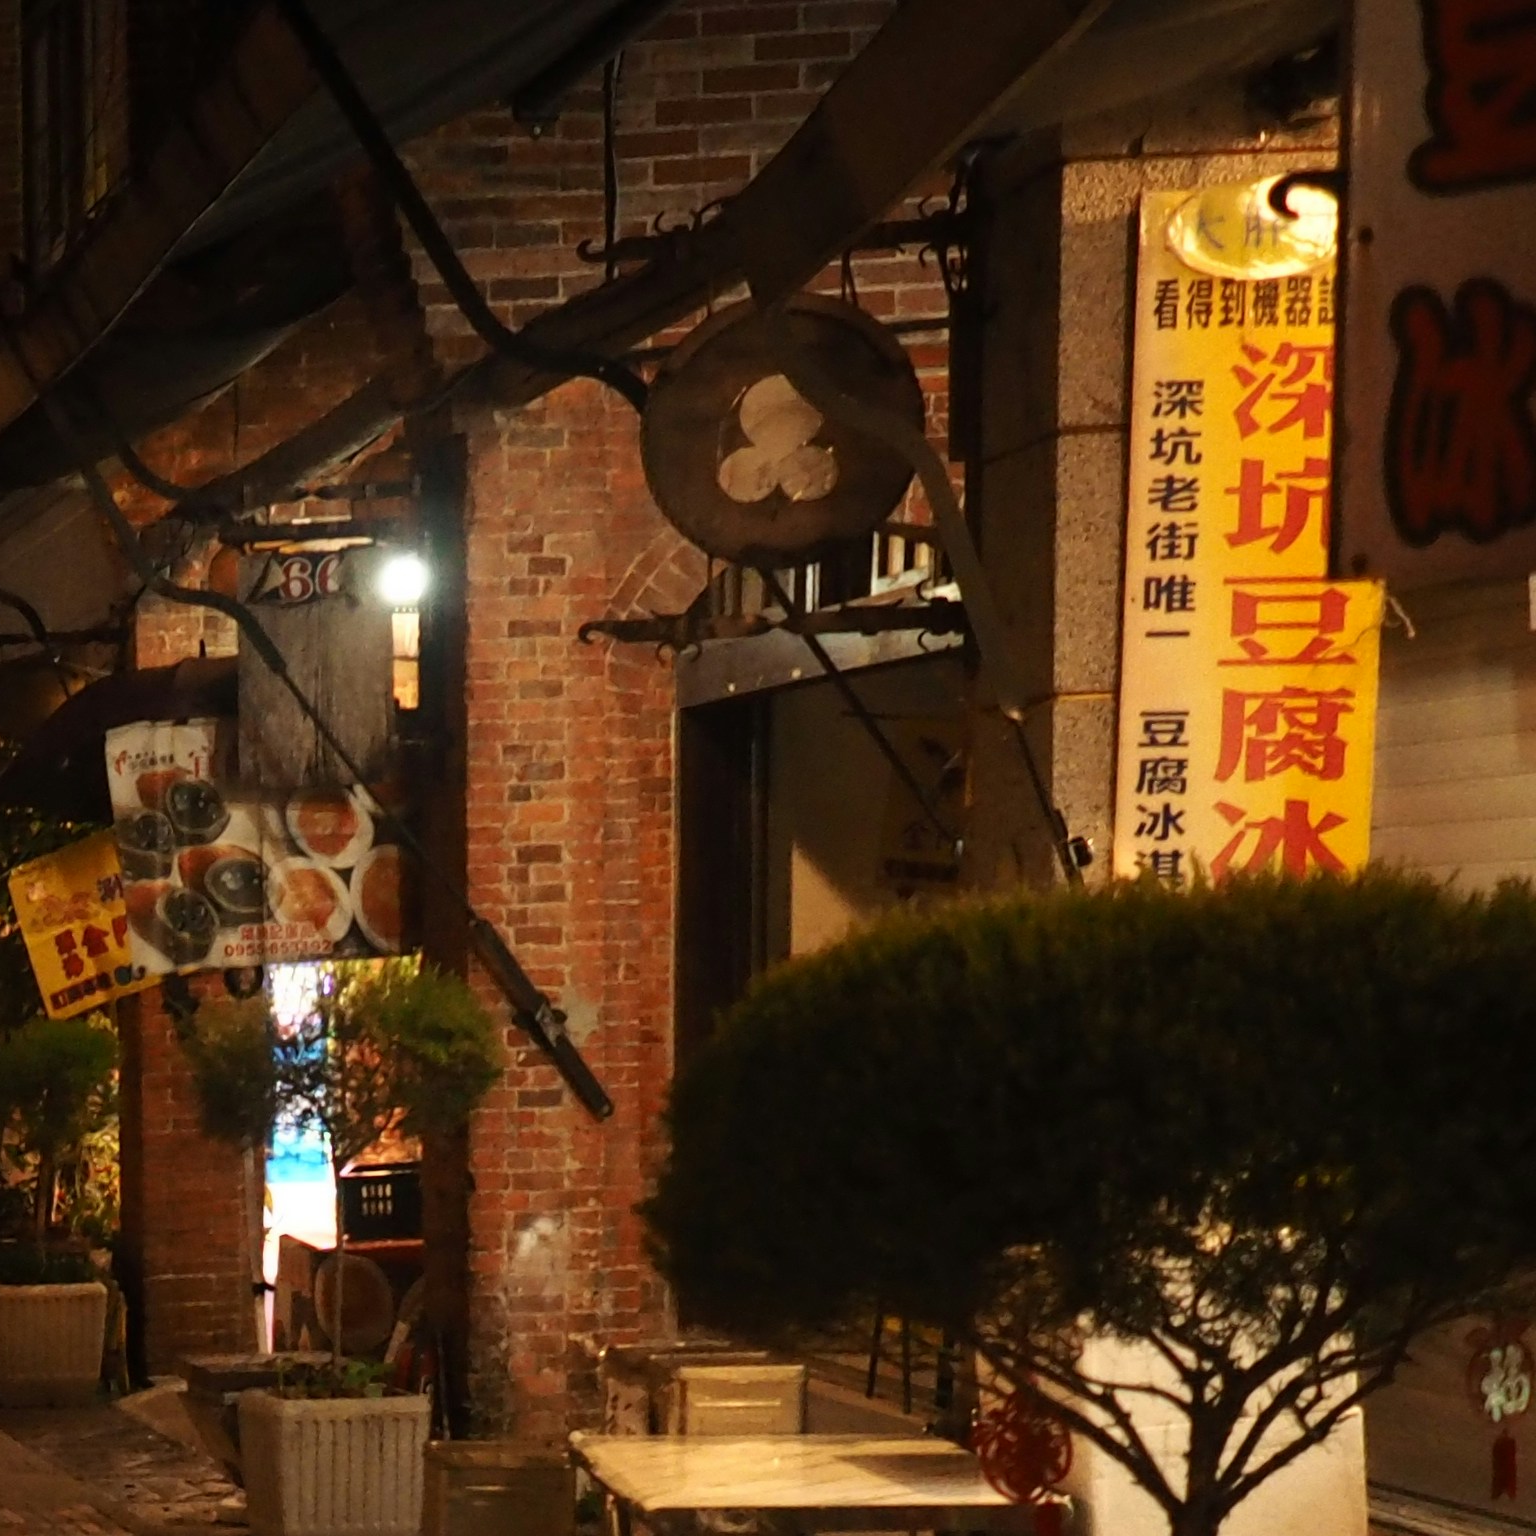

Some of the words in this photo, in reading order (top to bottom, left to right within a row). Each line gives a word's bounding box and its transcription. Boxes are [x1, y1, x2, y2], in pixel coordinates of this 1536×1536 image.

[1142, 379, 1204, 638] 深坑老街唯一
[1211, 341, 1357, 880] 深坑豆腐冰
